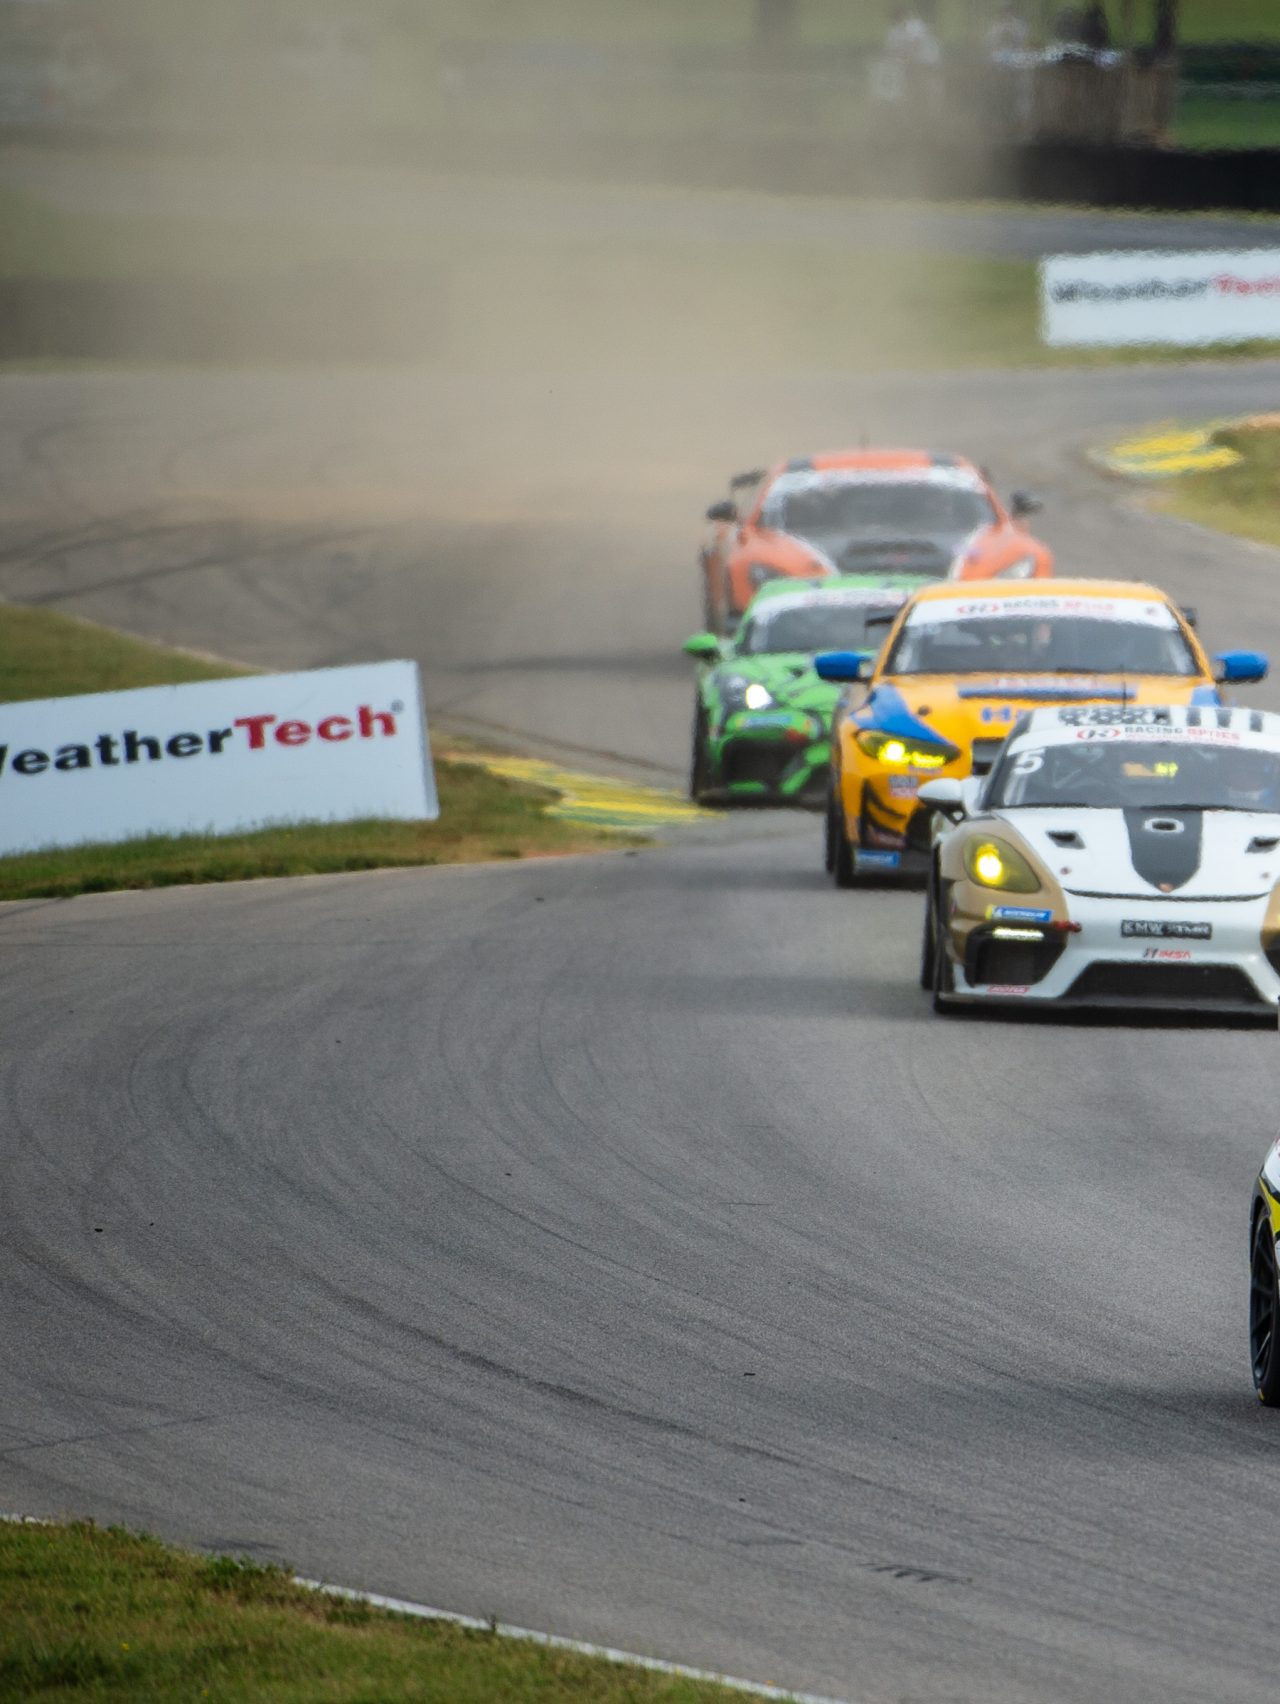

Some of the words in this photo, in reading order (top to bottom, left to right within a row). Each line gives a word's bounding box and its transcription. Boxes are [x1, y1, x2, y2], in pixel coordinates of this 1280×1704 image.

[0, 705, 397, 775] eatherTech
[1124, 725, 1184, 734] RACING
[1013, 749, 1045, 775] 5
